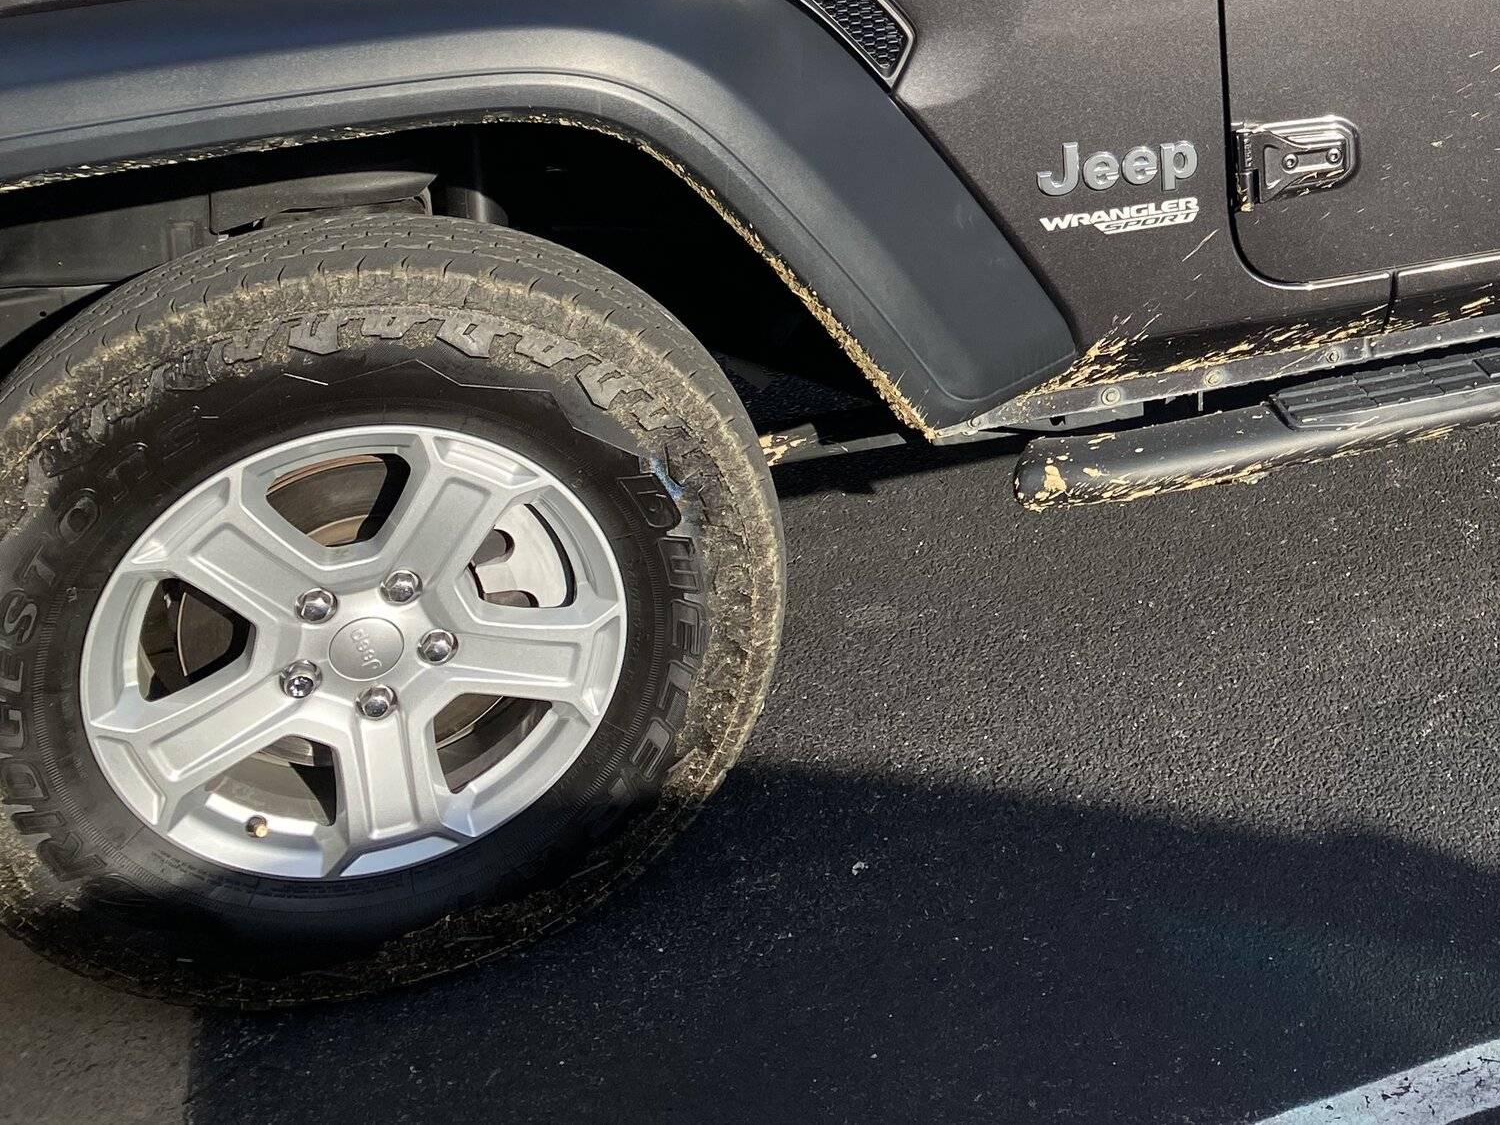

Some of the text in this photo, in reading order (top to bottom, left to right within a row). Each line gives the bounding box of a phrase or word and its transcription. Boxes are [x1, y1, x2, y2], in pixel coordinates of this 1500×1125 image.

[1037, 140, 1198, 196] Jeep
[1039, 197, 1199, 232] WRANGLER
[1104, 212, 1195, 231] SPORT
